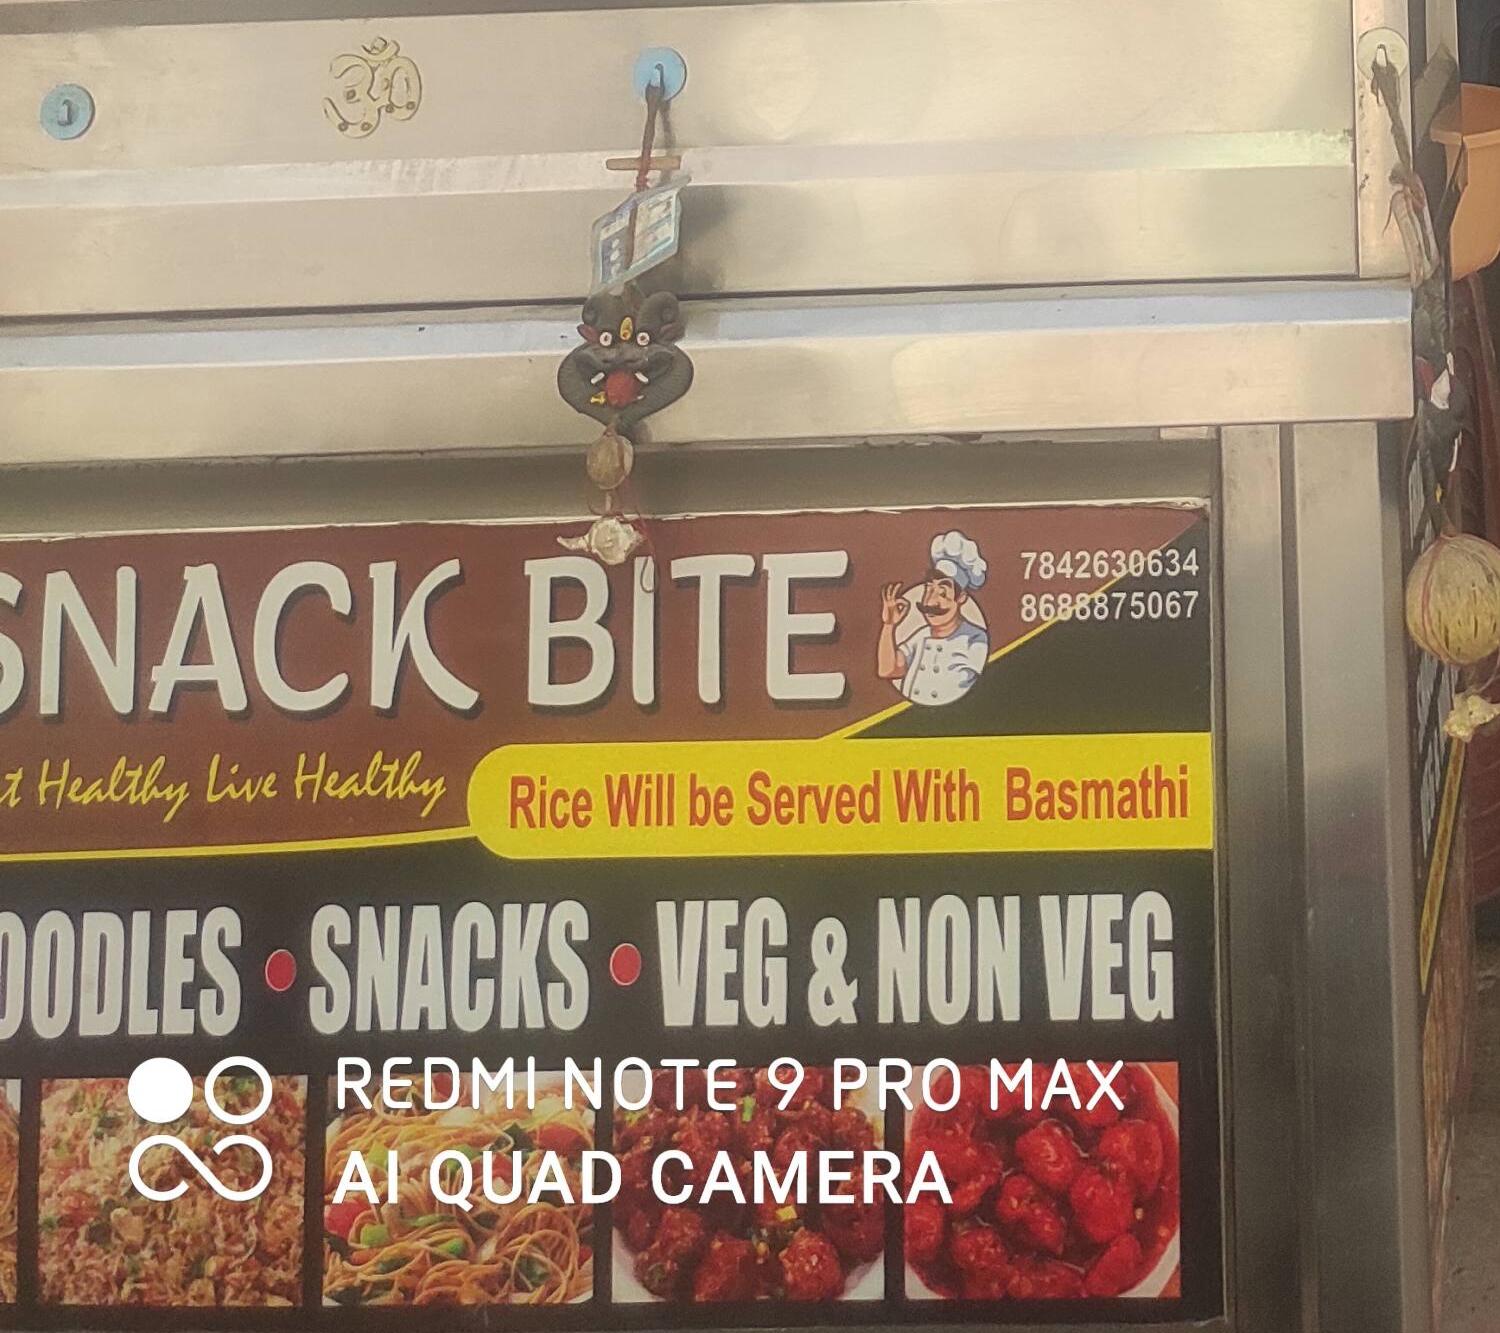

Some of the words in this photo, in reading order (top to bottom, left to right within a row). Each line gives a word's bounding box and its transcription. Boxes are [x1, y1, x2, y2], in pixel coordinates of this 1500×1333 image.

[1020, 547, 1200, 583] 7842630634
[524, 549, 850, 708] BITE
[1020, 590, 1200, 624] 8688875067
[39, 754, 191, 823] Healthy
[206, 752, 278, 807] Live
[294, 749, 449, 817] Healthy
[509, 773, 593, 829] Rice
[604, 770, 675, 827] Will
[689, 771, 735, 826] be
[746, 767, 882, 826] Served
[893, 766, 981, 823] With
[1006, 763, 1189, 821] Basmathi
[309, 898, 590, 1037] SNACKS
[655, 896, 789, 1028] VEG
[808, 916, 858, 1026] &
[877, 893, 1027, 1026] NON
[1038, 890, 1176, 1023] VEG
